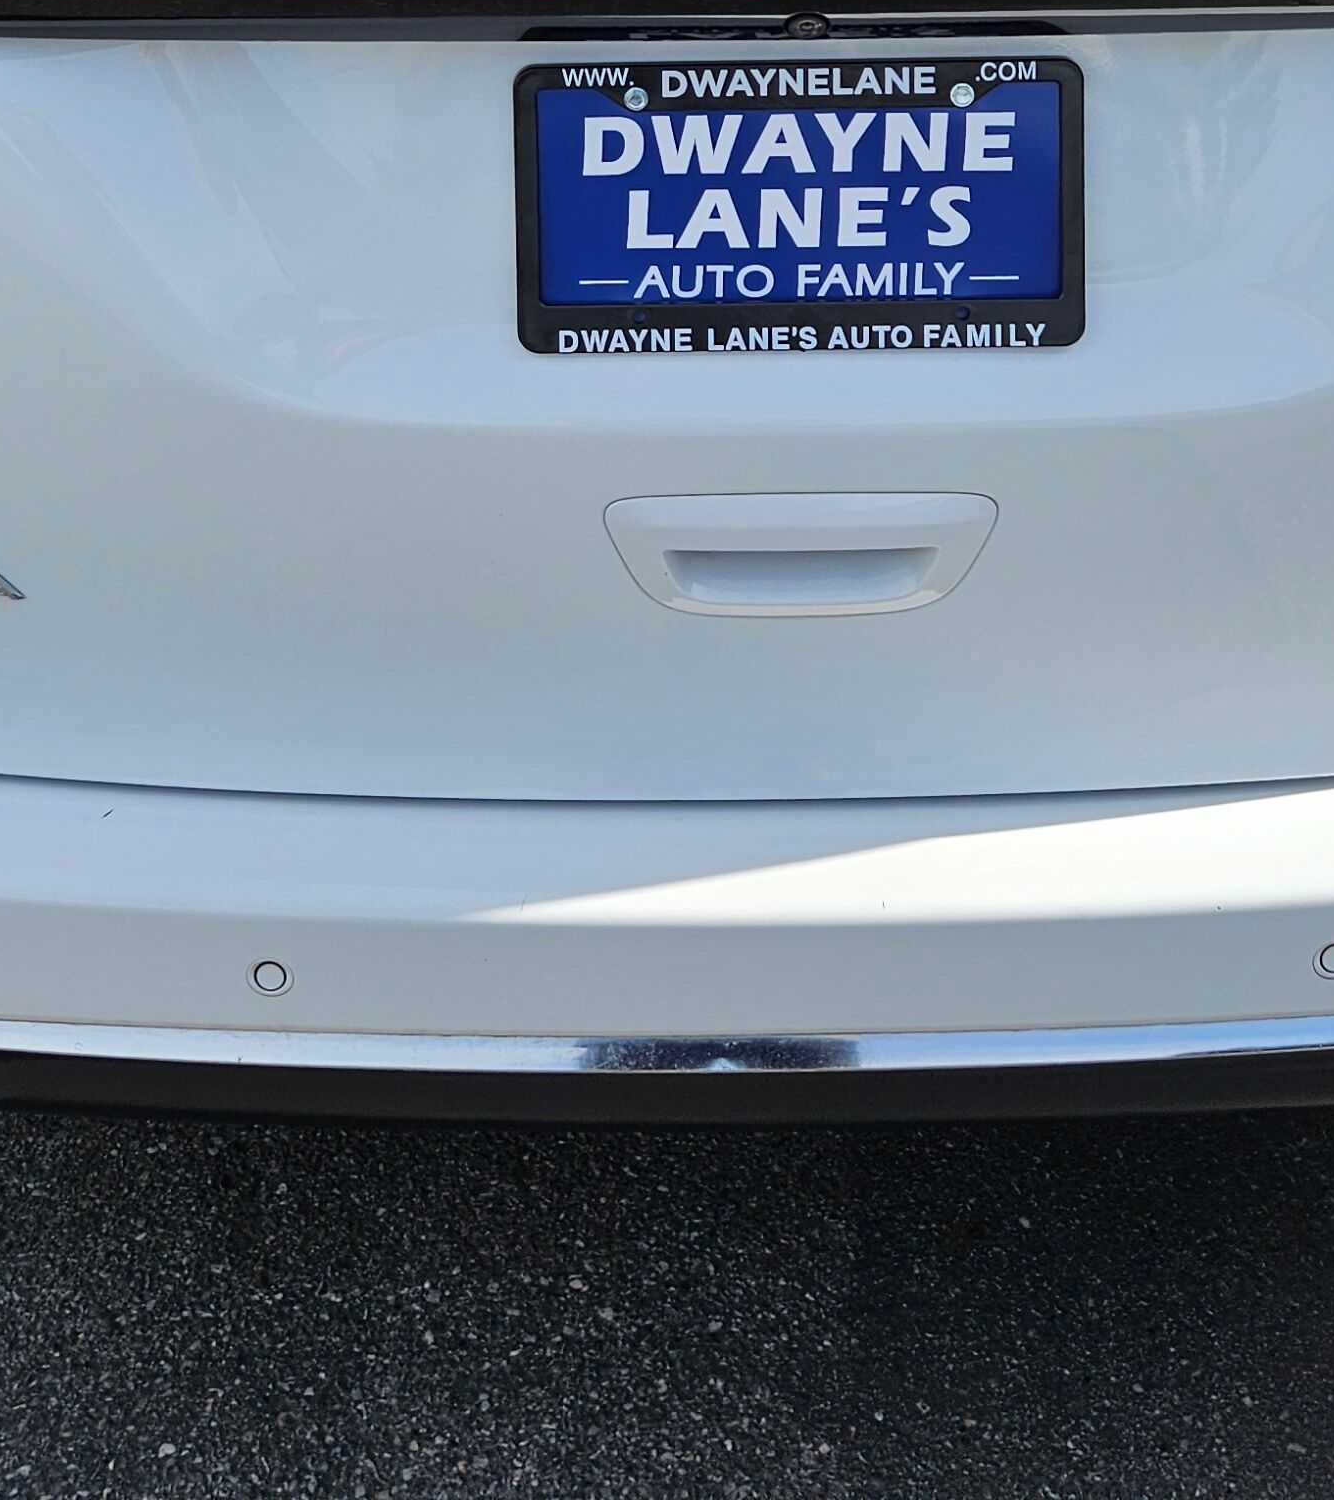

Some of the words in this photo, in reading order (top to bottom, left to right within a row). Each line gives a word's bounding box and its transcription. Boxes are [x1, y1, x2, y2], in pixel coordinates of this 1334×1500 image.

[562, 67, 635, 87] WWW.
[661, 67, 937, 98] DWAYNELANE
[975, 61, 1038, 82] .COM
[582, 112, 1017, 176] DWAYNE
[626, 186, 971, 249] LANE'S
[633, 264, 775, 299] AUTO
[796, 262, 965, 297] FAMILY
[558, 327, 693, 353] DWAYNE
[707, 325, 819, 351] LANE'S
[828, 325, 913, 350] AUTO
[923, 323, 1047, 348] FAMILY
